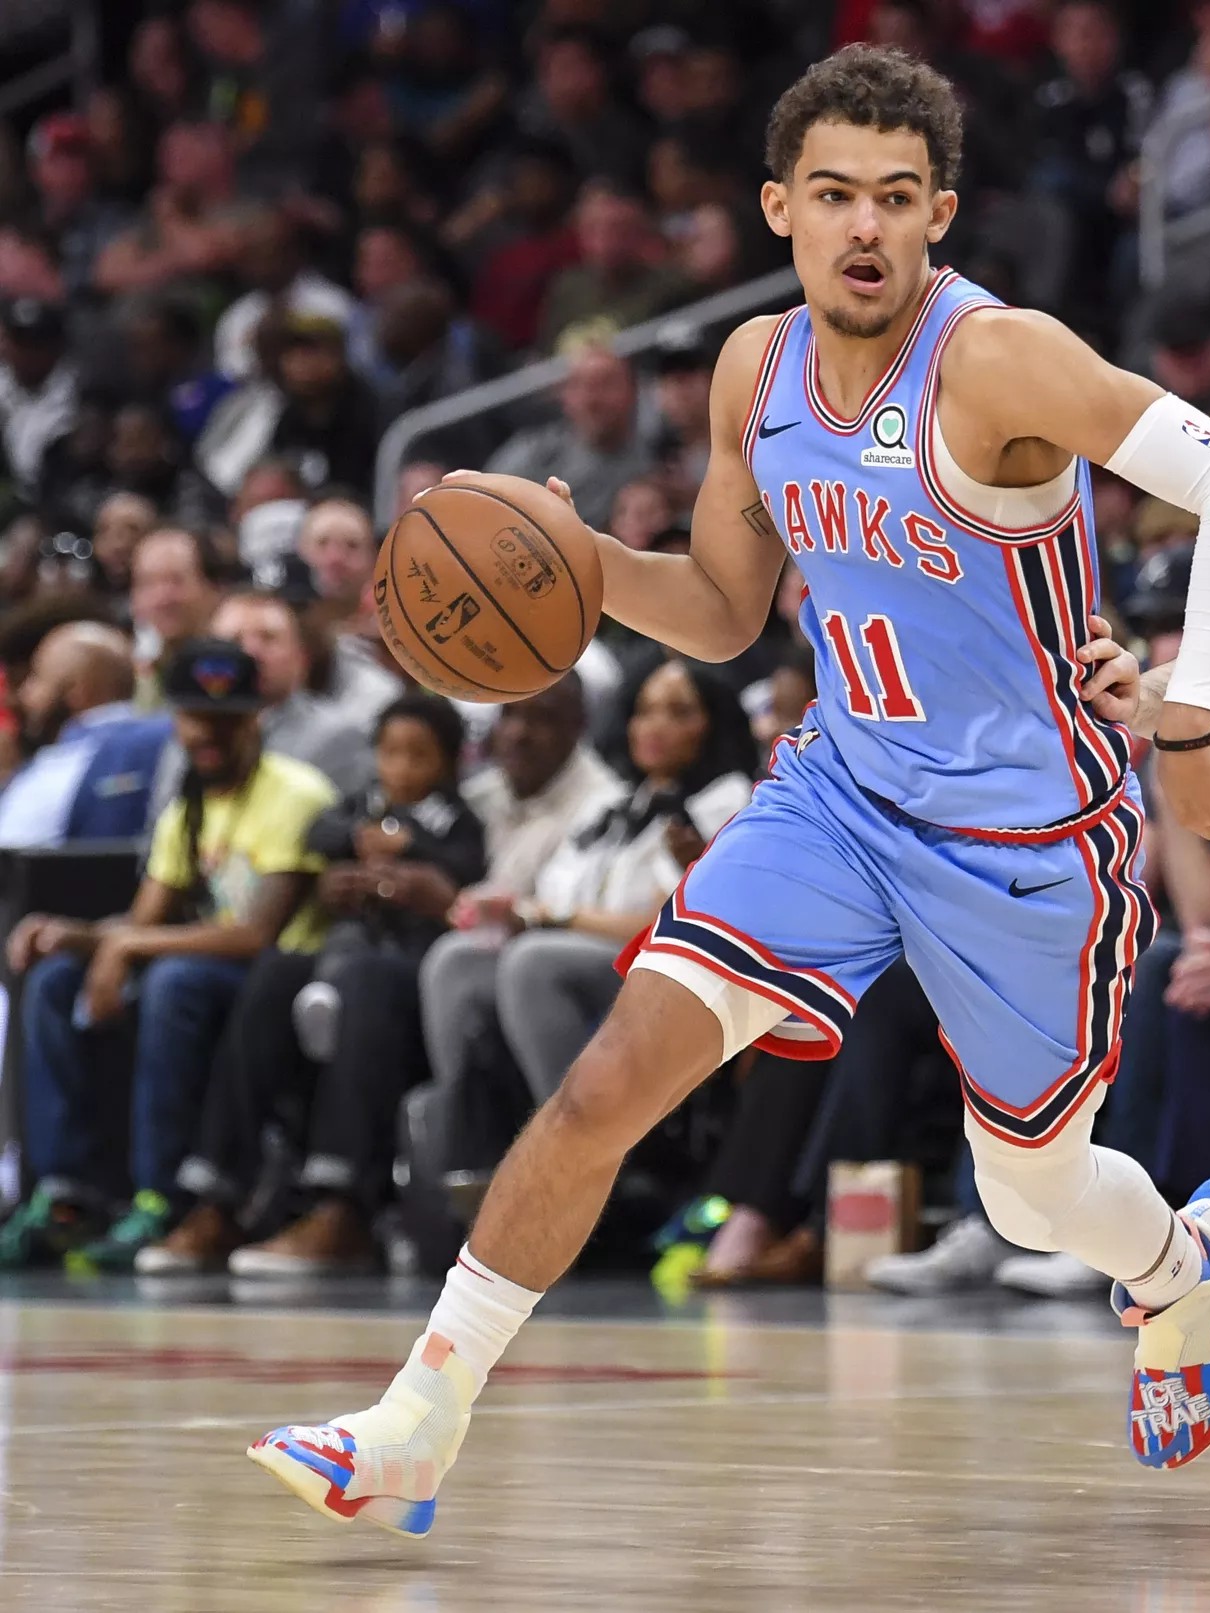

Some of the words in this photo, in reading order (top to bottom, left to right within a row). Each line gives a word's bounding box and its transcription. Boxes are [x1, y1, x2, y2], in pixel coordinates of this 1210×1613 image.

[863, 452, 912, 465] sharecare
[761, 479, 964, 585] AWKS
[822, 609, 927, 722] 11
[1139, 1377, 1190, 1411] ICE
